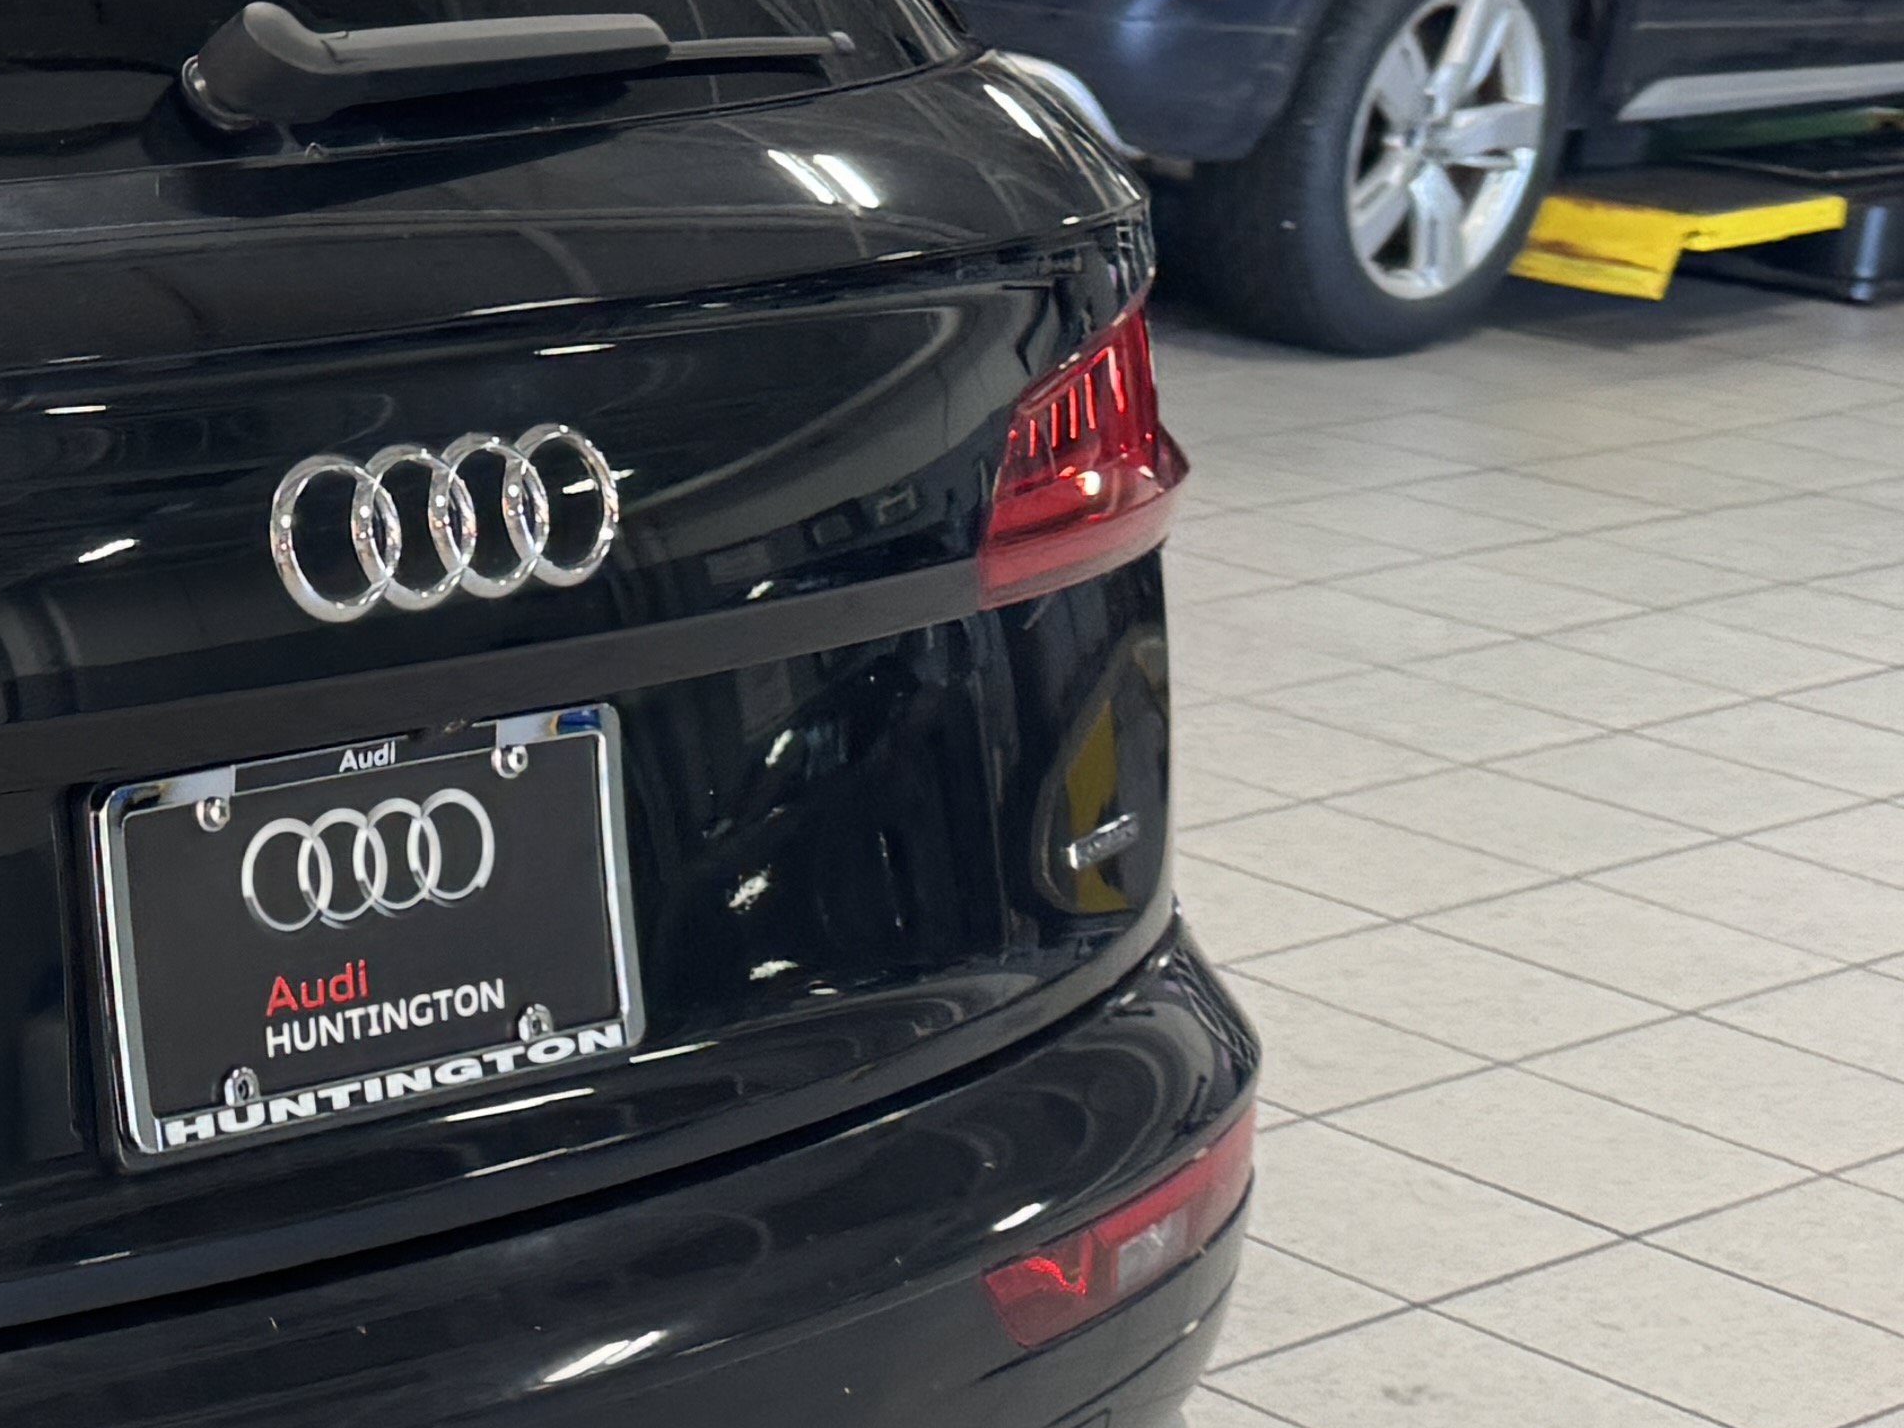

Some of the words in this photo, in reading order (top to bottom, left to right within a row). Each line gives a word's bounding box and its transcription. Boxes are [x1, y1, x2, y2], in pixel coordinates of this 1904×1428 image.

[339, 740, 396, 772] Audi
[266, 959, 368, 1016] Audi
[266, 978, 505, 1058] HUNTINGTON
[165, 1024, 624, 1146] HUNTINGTON
